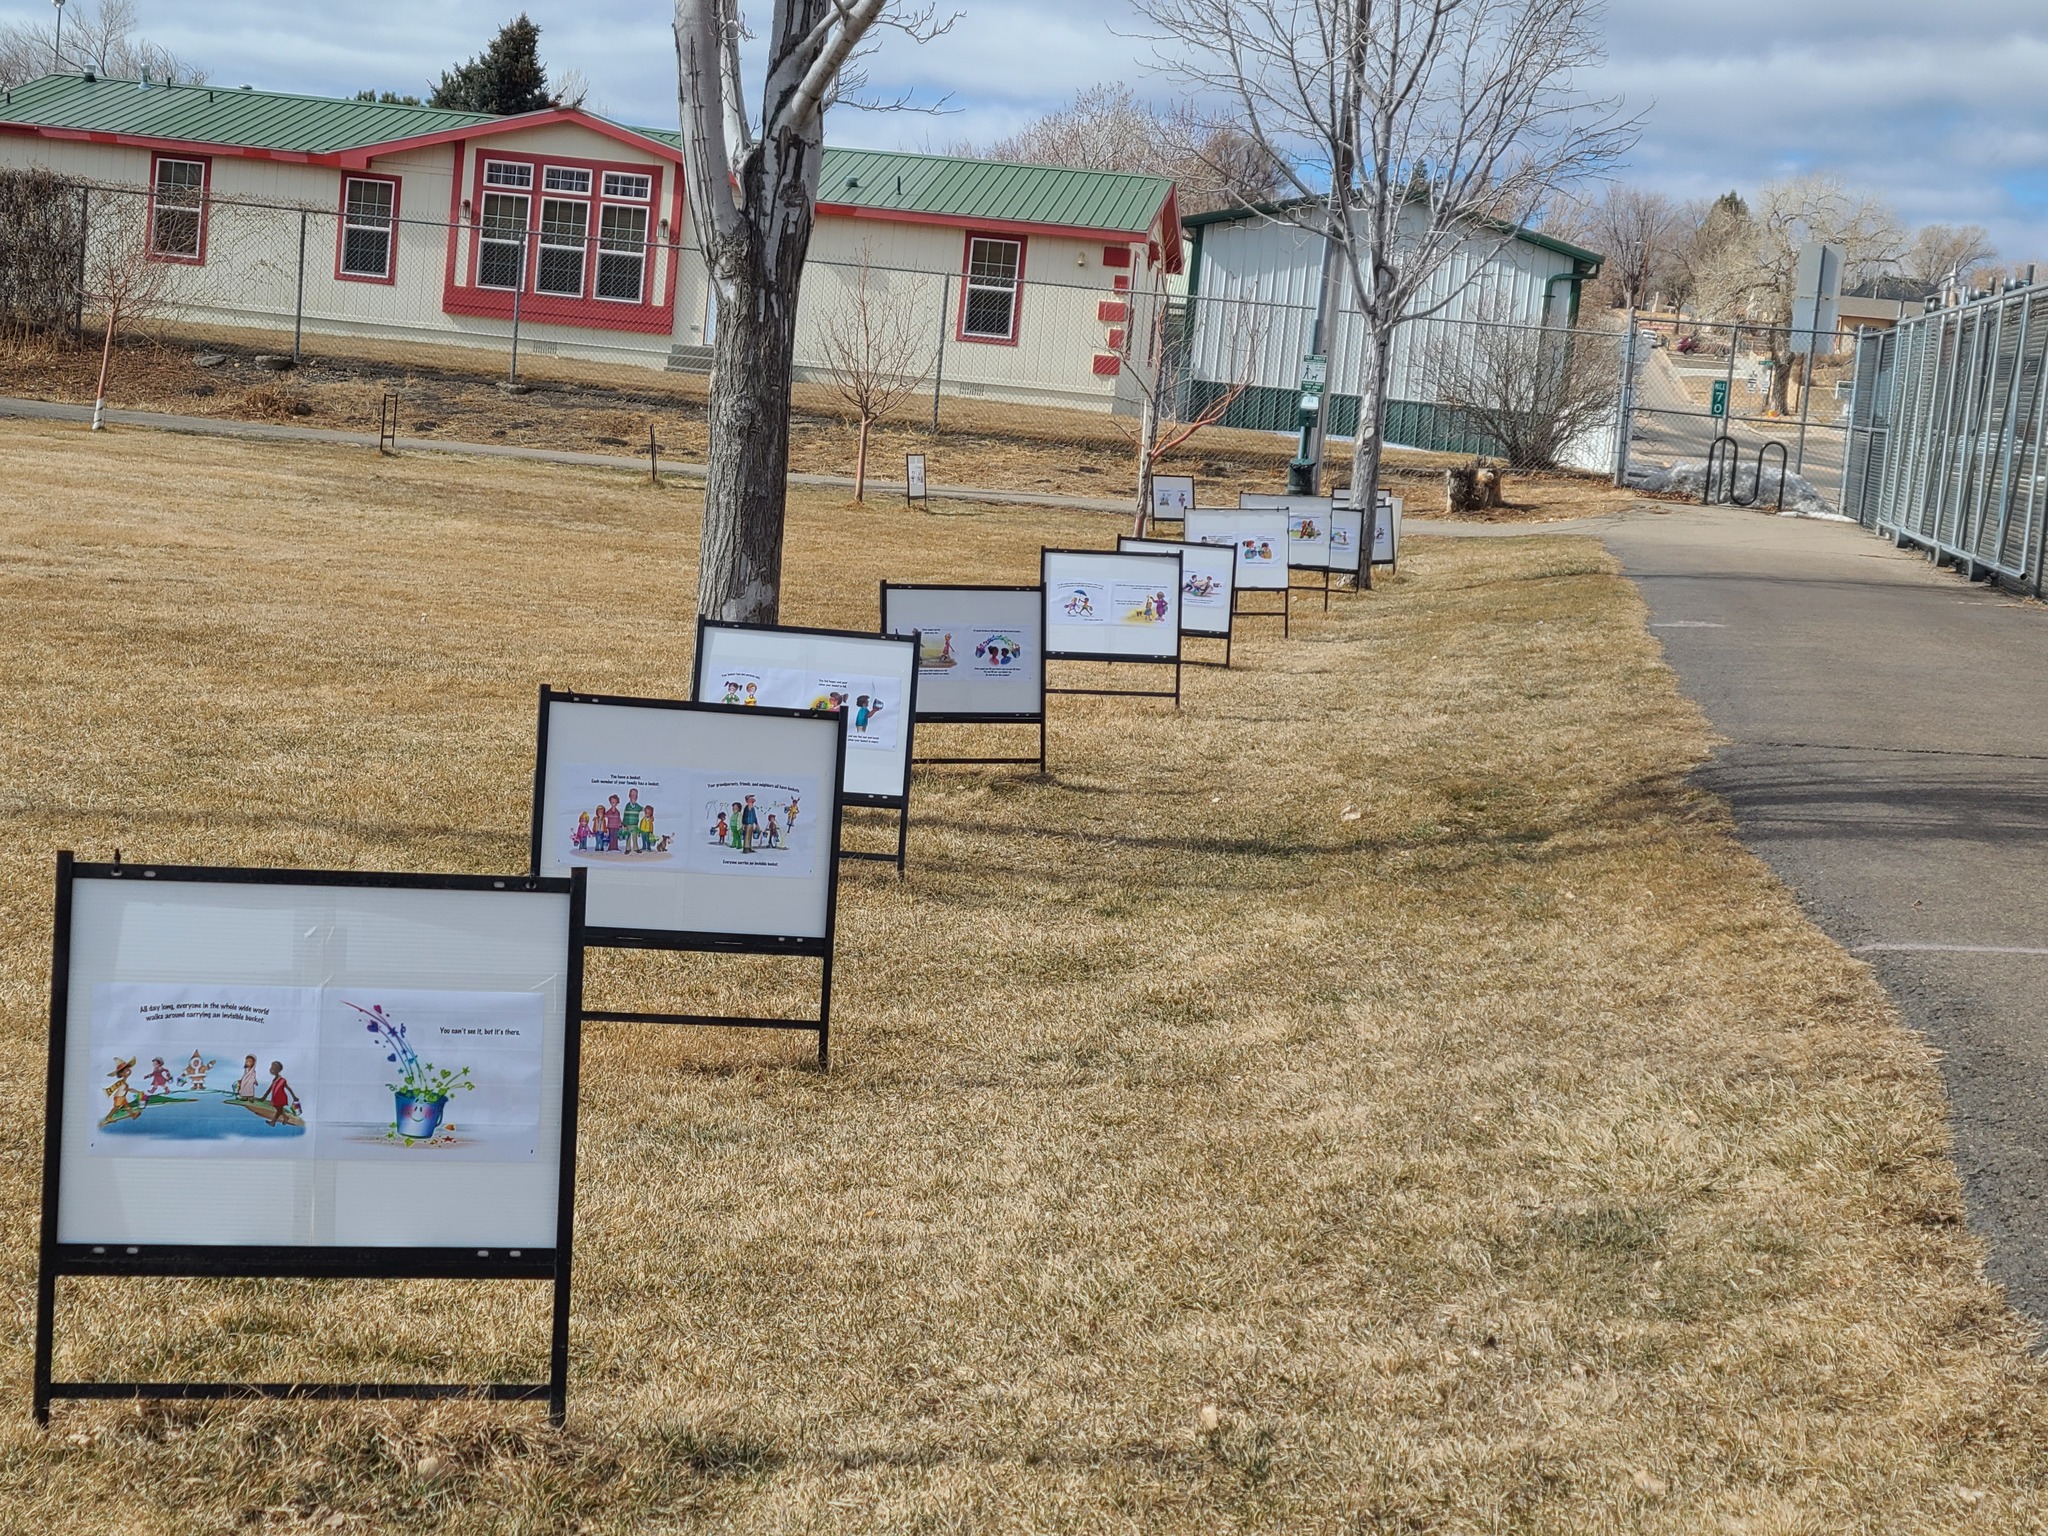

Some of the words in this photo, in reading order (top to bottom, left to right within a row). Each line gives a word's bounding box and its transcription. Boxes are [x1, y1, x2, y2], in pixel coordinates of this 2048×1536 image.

[140, 1005, 148, 1013] All
[149, 1004, 160, 1012] day
[203, 1001, 209, 1009] in
[210, 1001, 219, 1010] the
[220, 1002, 237, 1011] whole
[239, 1004, 252, 1012] wide
[253, 1007, 270, 1016] world
[145, 1013, 164, 1021] walks
[165, 1011, 186, 1019] around
[186, 1011, 212, 1019] carrying
[222, 1011, 244, 1021] invisible
[440, 1026, 450, 1035] You
[484, 1028, 494, 1036] but
